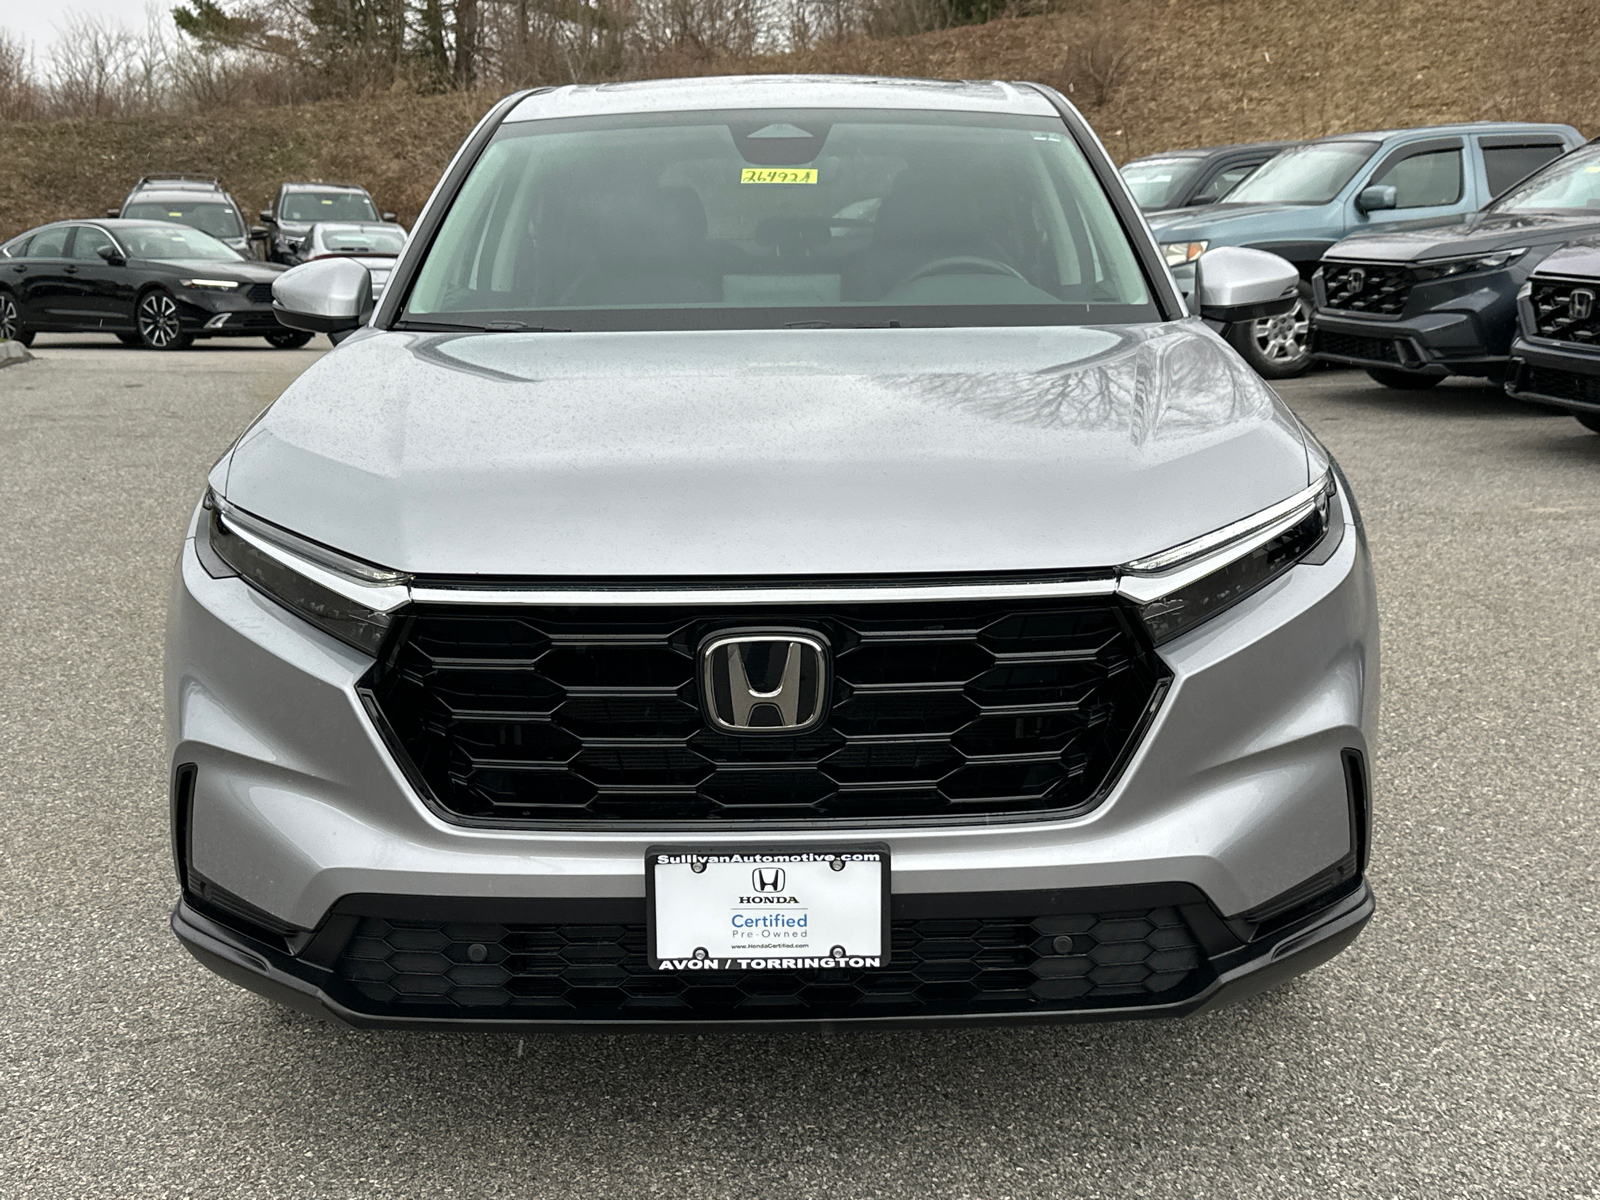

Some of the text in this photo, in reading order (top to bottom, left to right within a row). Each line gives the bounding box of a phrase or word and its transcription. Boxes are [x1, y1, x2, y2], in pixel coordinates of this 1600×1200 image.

[657, 853, 880, 864] SullivanAutomotive.com
[739, 896, 800, 904] HONDA
[731, 913, 808, 928] Certified
[732, 929, 808, 938] Pre-Owned
[658, 959, 718, 970] AVON
[738, 957, 880, 969] TORRINGTON
